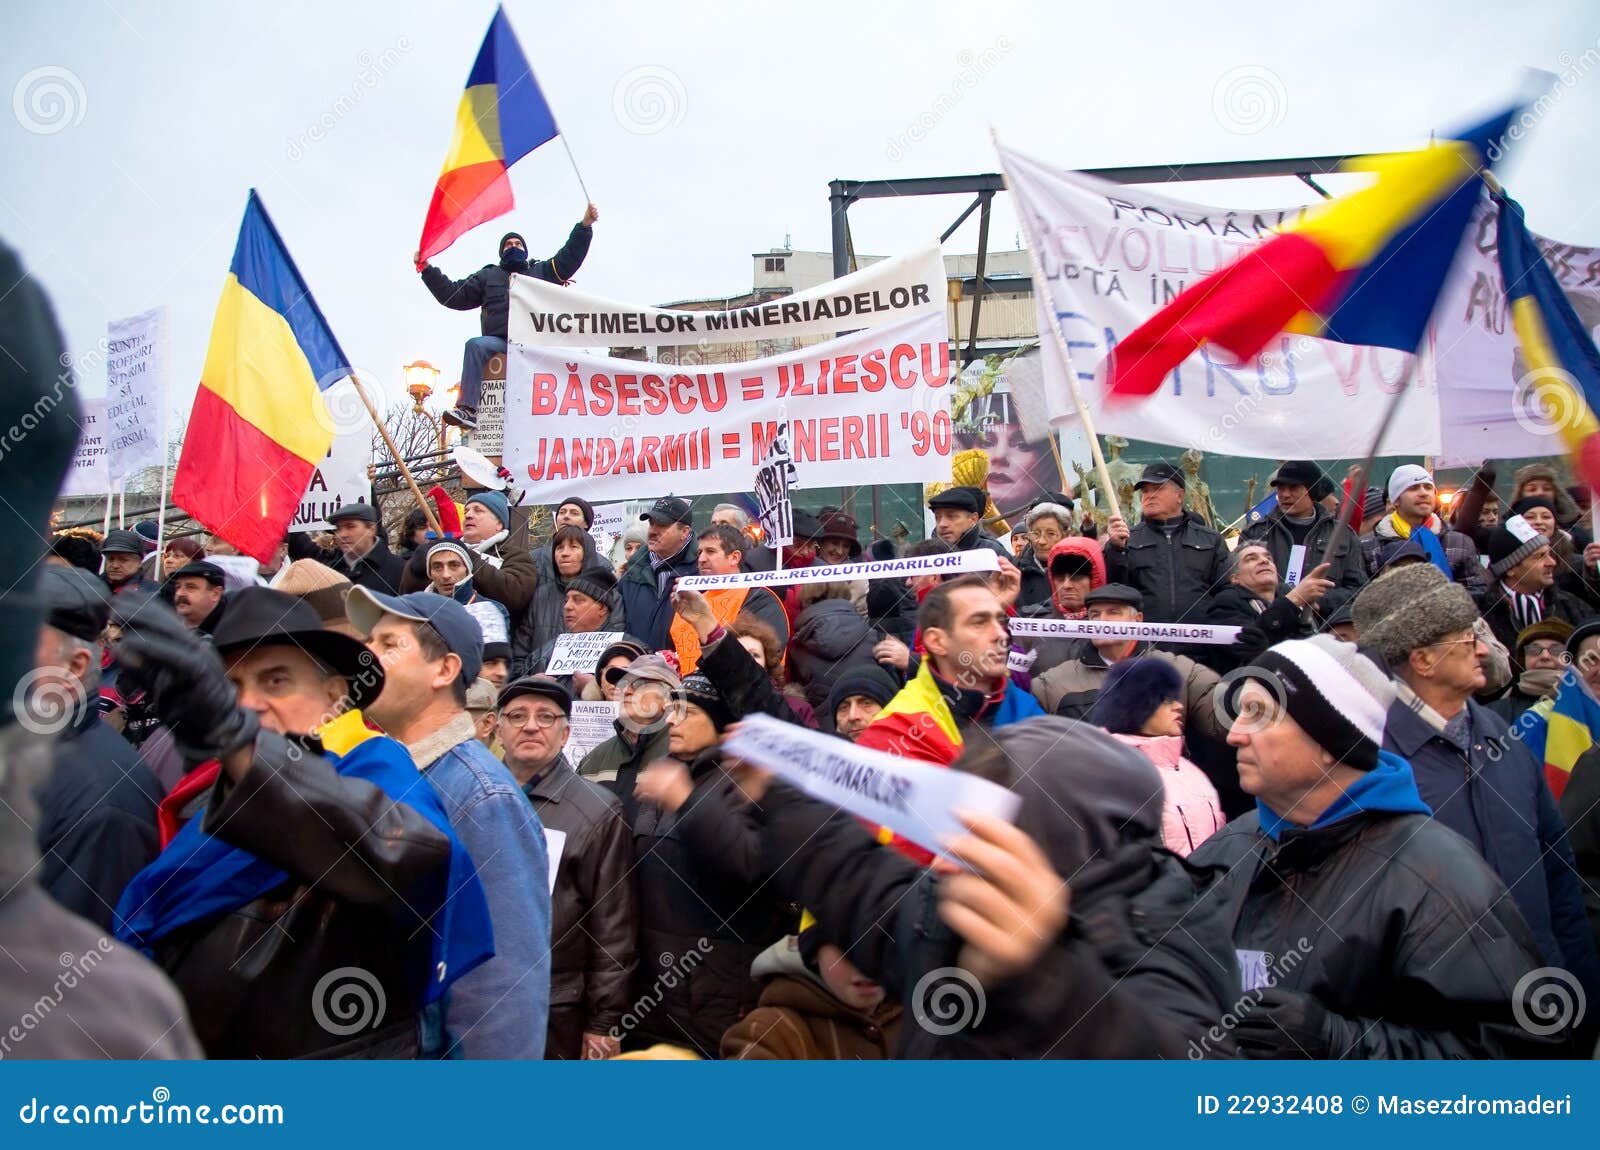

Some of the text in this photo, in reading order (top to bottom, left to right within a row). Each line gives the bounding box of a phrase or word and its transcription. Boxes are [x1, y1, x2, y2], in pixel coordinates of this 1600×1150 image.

[530, 283, 930, 334] VICTIMELOR MINERIADELOR
[531, 362, 728, 416] BĂSESCU
[776, 341, 949, 399] ILIESCU
[528, 426, 711, 482] JANDARMII
[751, 412, 891, 466] MNERII
[683, 574, 739, 587] CINSTE
[575, 704, 611, 715] WANTED
